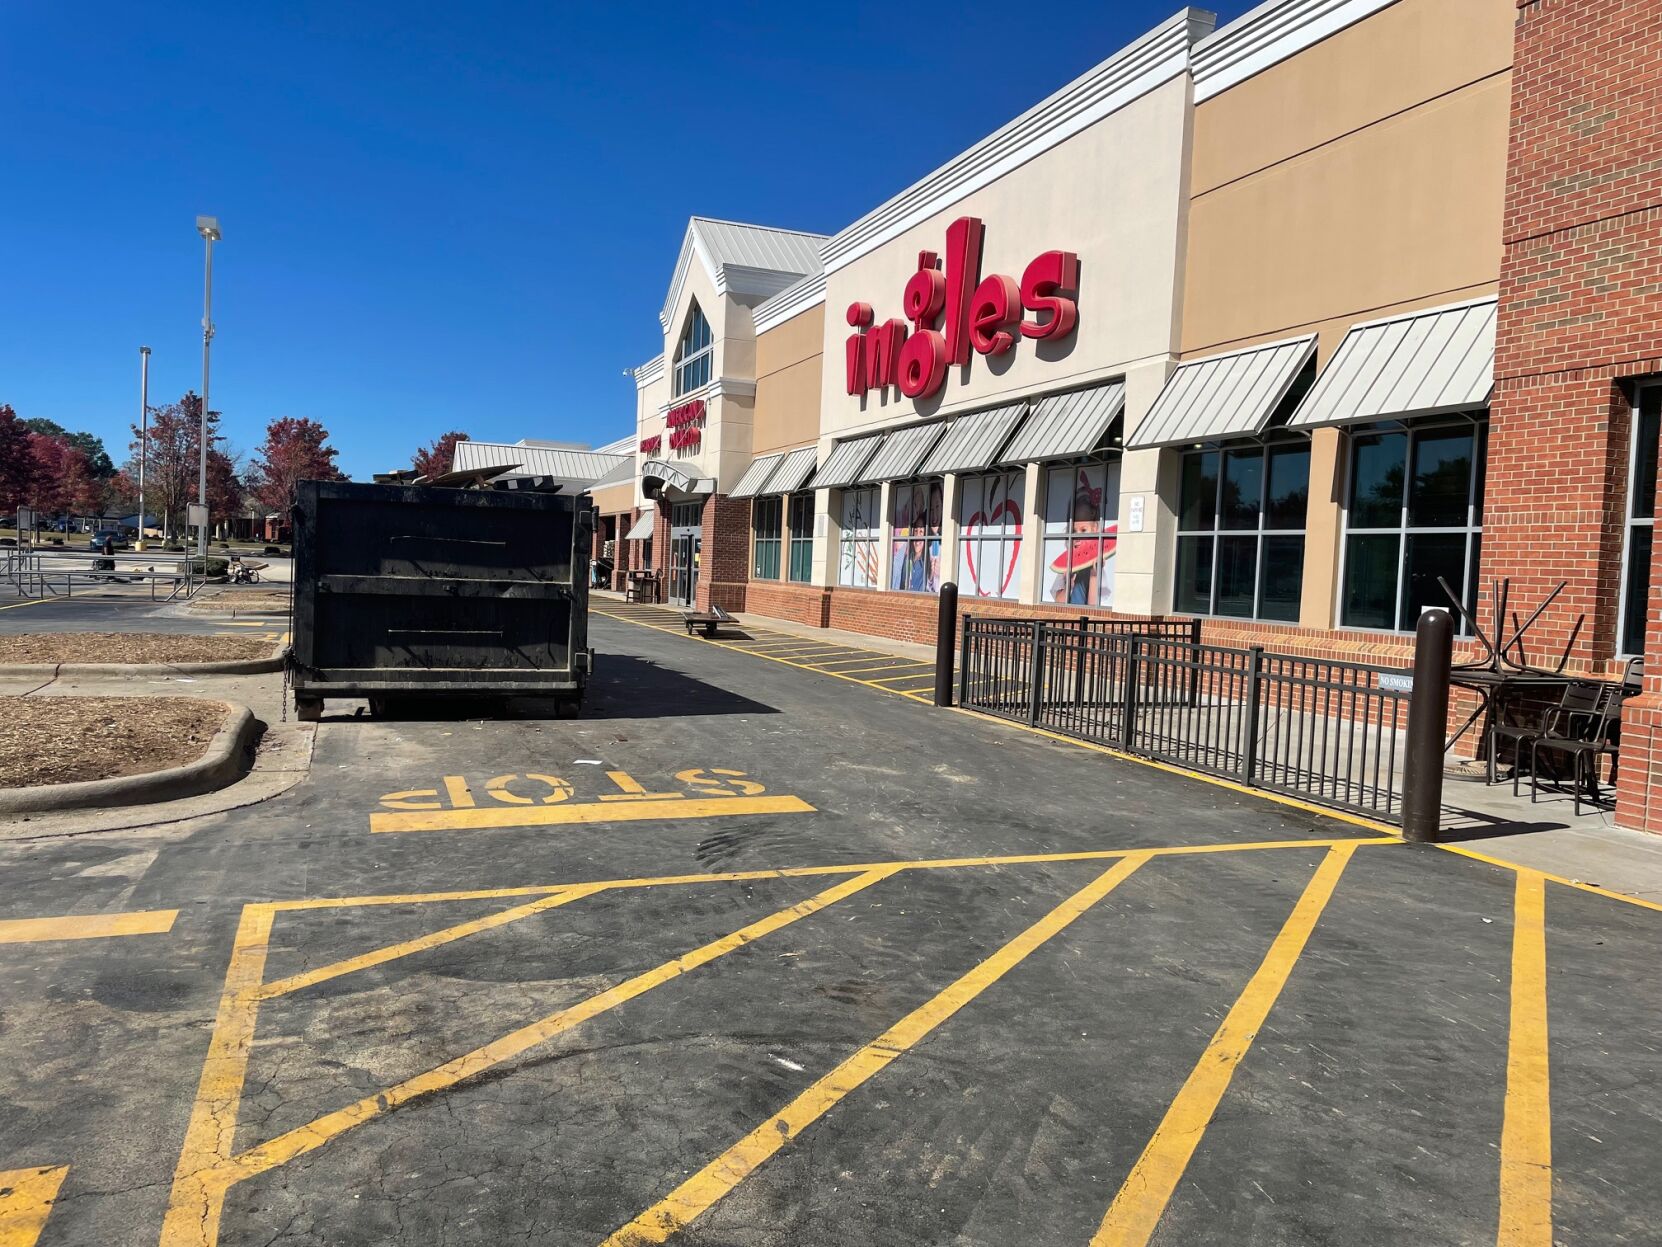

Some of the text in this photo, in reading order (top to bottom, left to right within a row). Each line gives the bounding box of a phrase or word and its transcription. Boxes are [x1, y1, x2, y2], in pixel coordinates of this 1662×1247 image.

[846, 216, 1077, 400] ingles
[1380, 676, 1390, 686] NO
[378, 768, 766, 810] STOP
